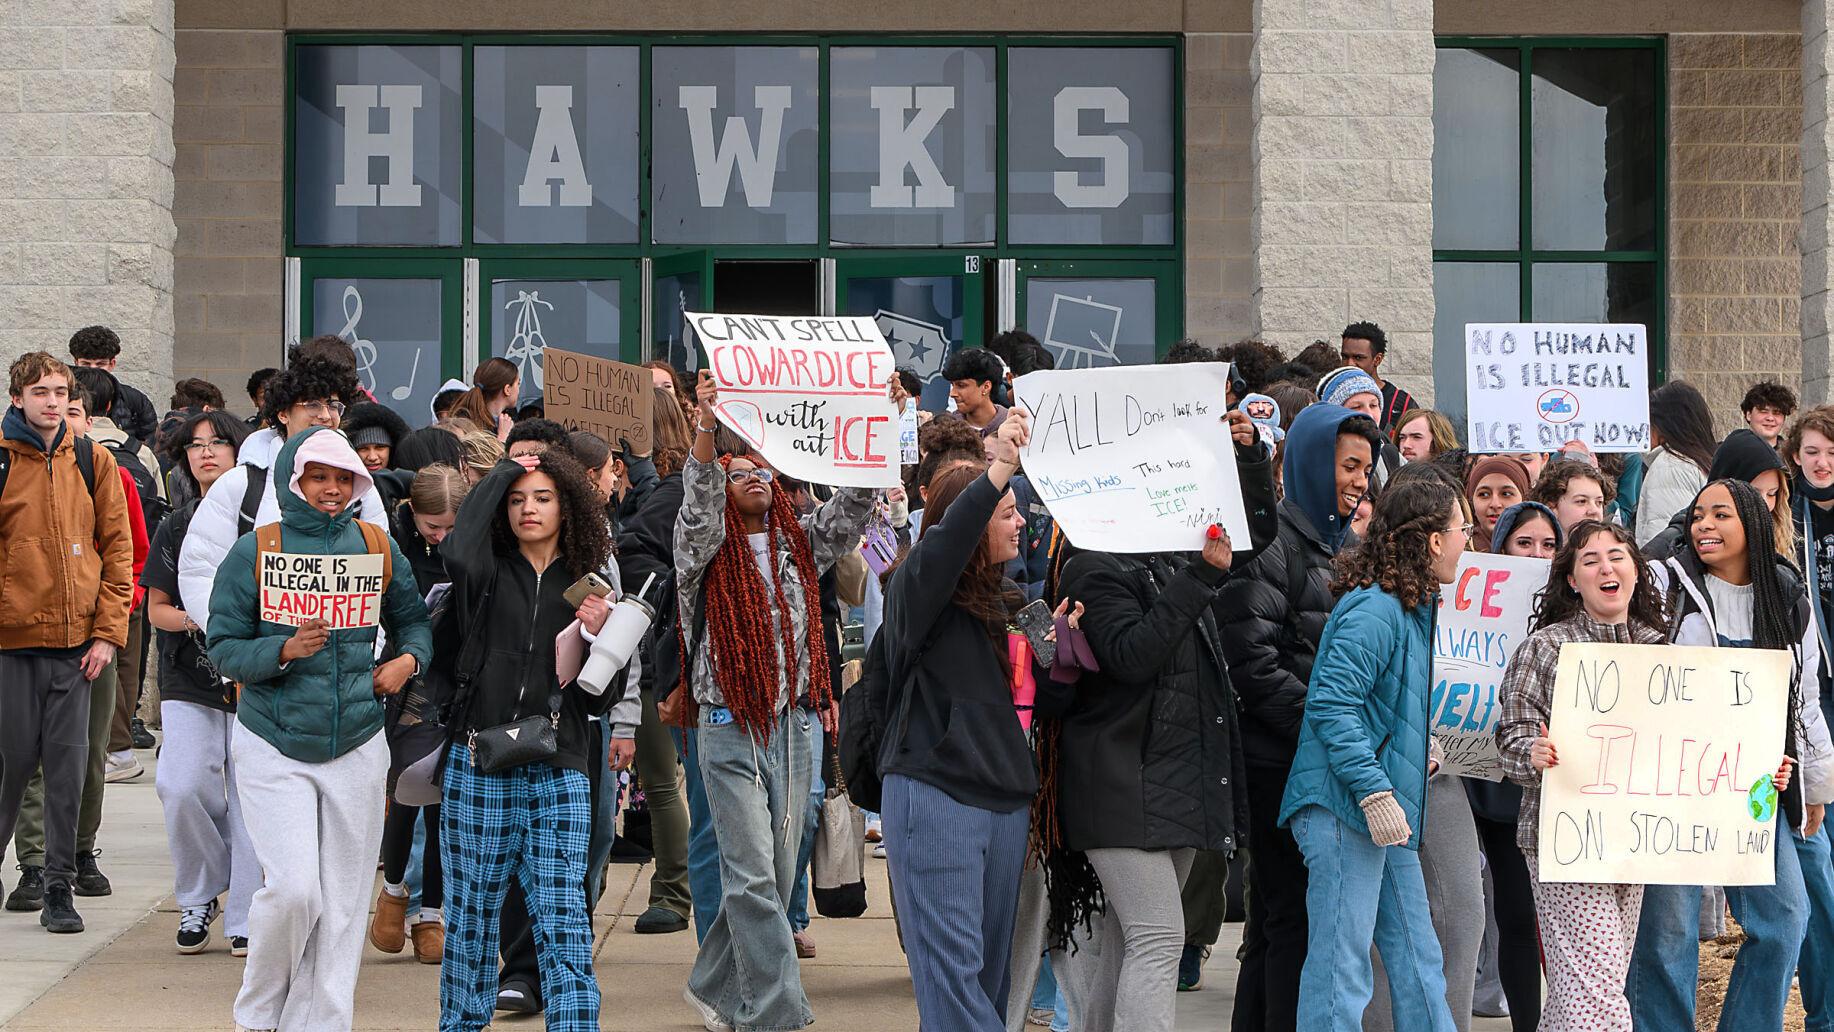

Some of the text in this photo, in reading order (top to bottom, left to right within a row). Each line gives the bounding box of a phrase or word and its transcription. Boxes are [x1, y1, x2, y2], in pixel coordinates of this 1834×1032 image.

[335, 84, 1130, 208] HAWKS
[966, 256, 979, 272] 13
[791, 319, 874, 343] SPELL
[1473, 329, 1636, 355] NO HUMAN
[548, 354, 640, 394] NO HUMAN
[713, 345, 887, 390] COWARDICE
[1475, 362, 1631, 390] IS ILLEGAL
[545, 383, 640, 419] IS ILLEGAL
[1173, 402, 1192, 418] look
[1195, 401, 1209, 416] for
[766, 400, 830, 431] with
[793, 433, 835, 457] out
[1474, 421, 1526, 449] ICE
[1537, 421, 1586, 447] OUT
[1132, 459, 1191, 478] This hard
[1146, 487, 1171, 501] Love
[1150, 496, 1188, 518] ICE!
[262, 555, 348, 575] NO ONE IS
[264, 571, 383, 593] ILLEGAL IN THE
[1438, 566, 1512, 619] CE
[262, 611, 283, 624] OF
[1433, 627, 1508, 668] LWAYS
[1575, 659, 1753, 713] NO ONE IS
[1579, 724, 1748, 796] ILLEGAL
[1554, 809, 1770, 865] ON STOLEN LAND
